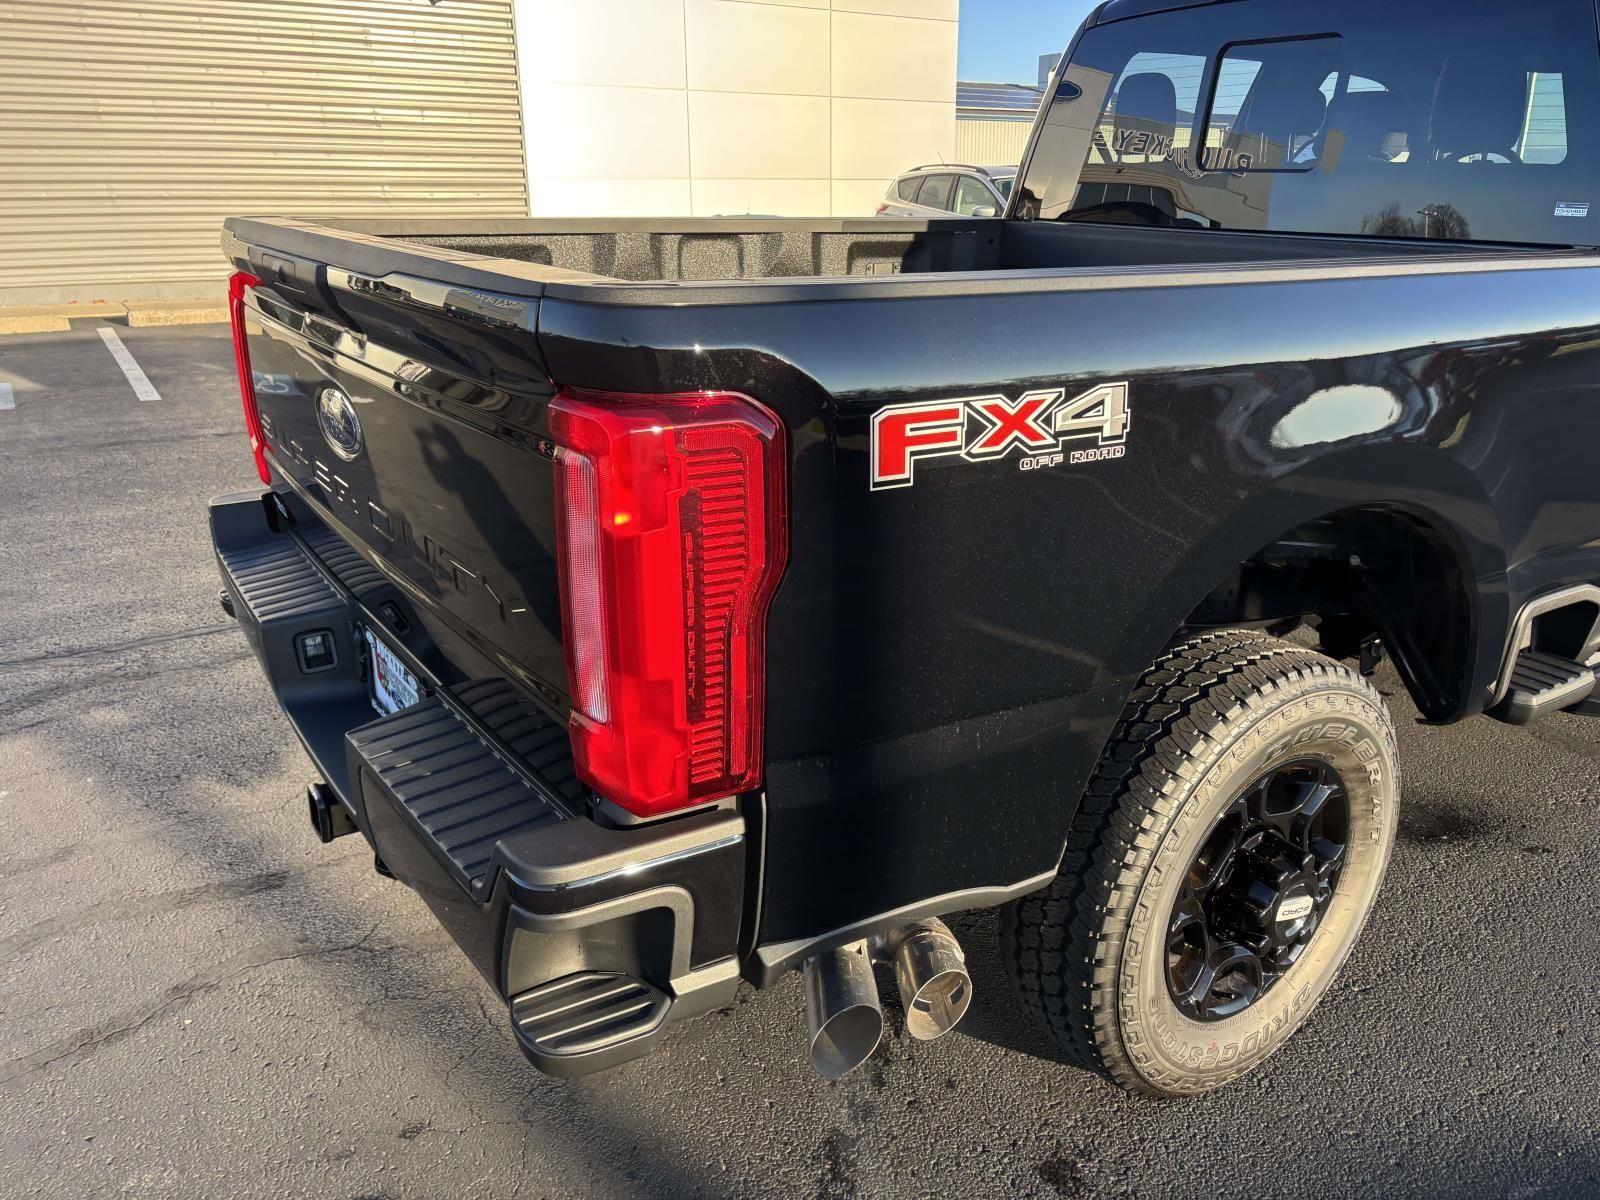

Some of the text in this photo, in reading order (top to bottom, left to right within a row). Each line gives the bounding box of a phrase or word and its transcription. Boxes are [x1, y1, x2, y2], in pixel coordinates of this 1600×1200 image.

[869, 381, 1131, 492] FX4
[1019, 445, 1125, 471] OFF ROAD
[1266, 722, 1384, 786] DUELER
[1281, 905, 1311, 917] FORD
[1150, 981, 1313, 1070] BRIDGESTONE
